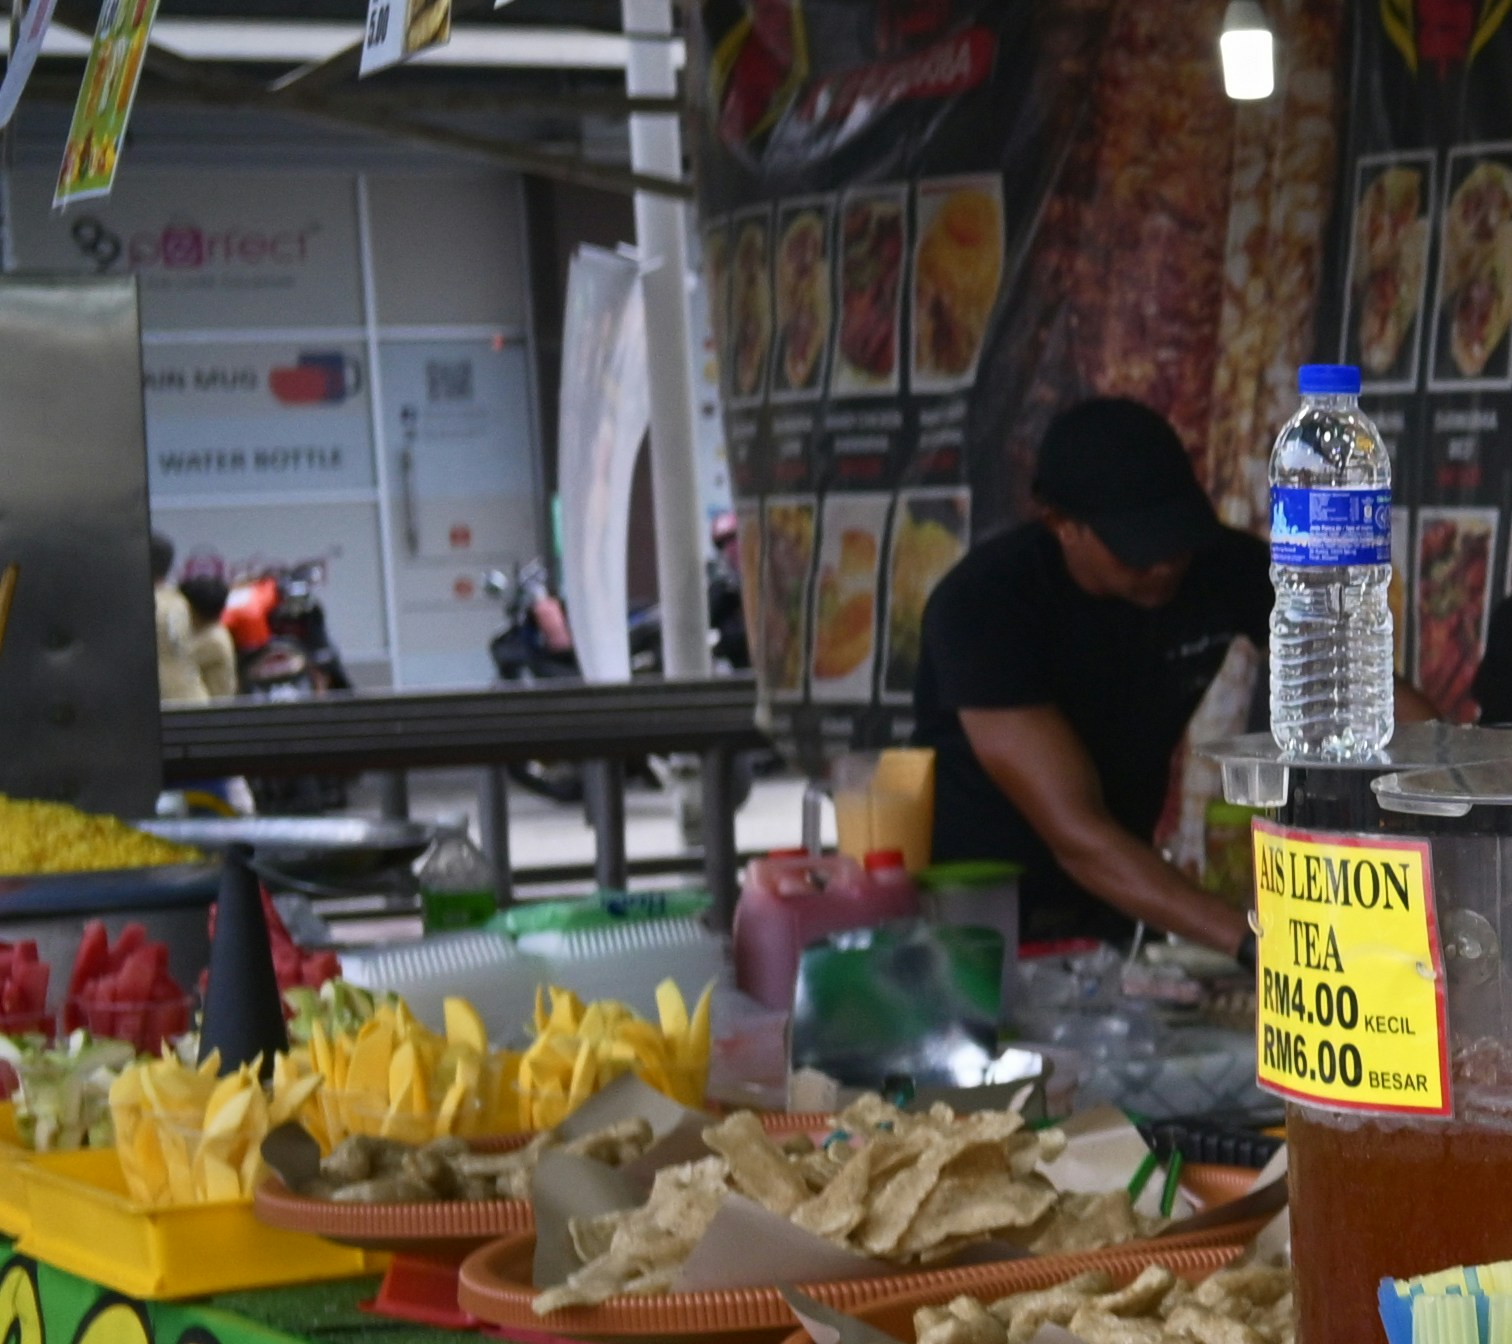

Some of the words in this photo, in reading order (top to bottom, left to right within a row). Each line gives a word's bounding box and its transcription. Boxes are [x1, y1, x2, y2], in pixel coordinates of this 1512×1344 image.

[1260, 846, 1286, 897] AIS
[1289, 853, 1411, 913] LEMON
[1288, 918, 1344, 973] TEA
[1263, 967, 1359, 1031] RM4.00
[1364, 1014, 1416, 1037] KECIL
[1263, 1023, 1363, 1088] RM6.00
[1368, 1069, 1429, 1093] BESAR
